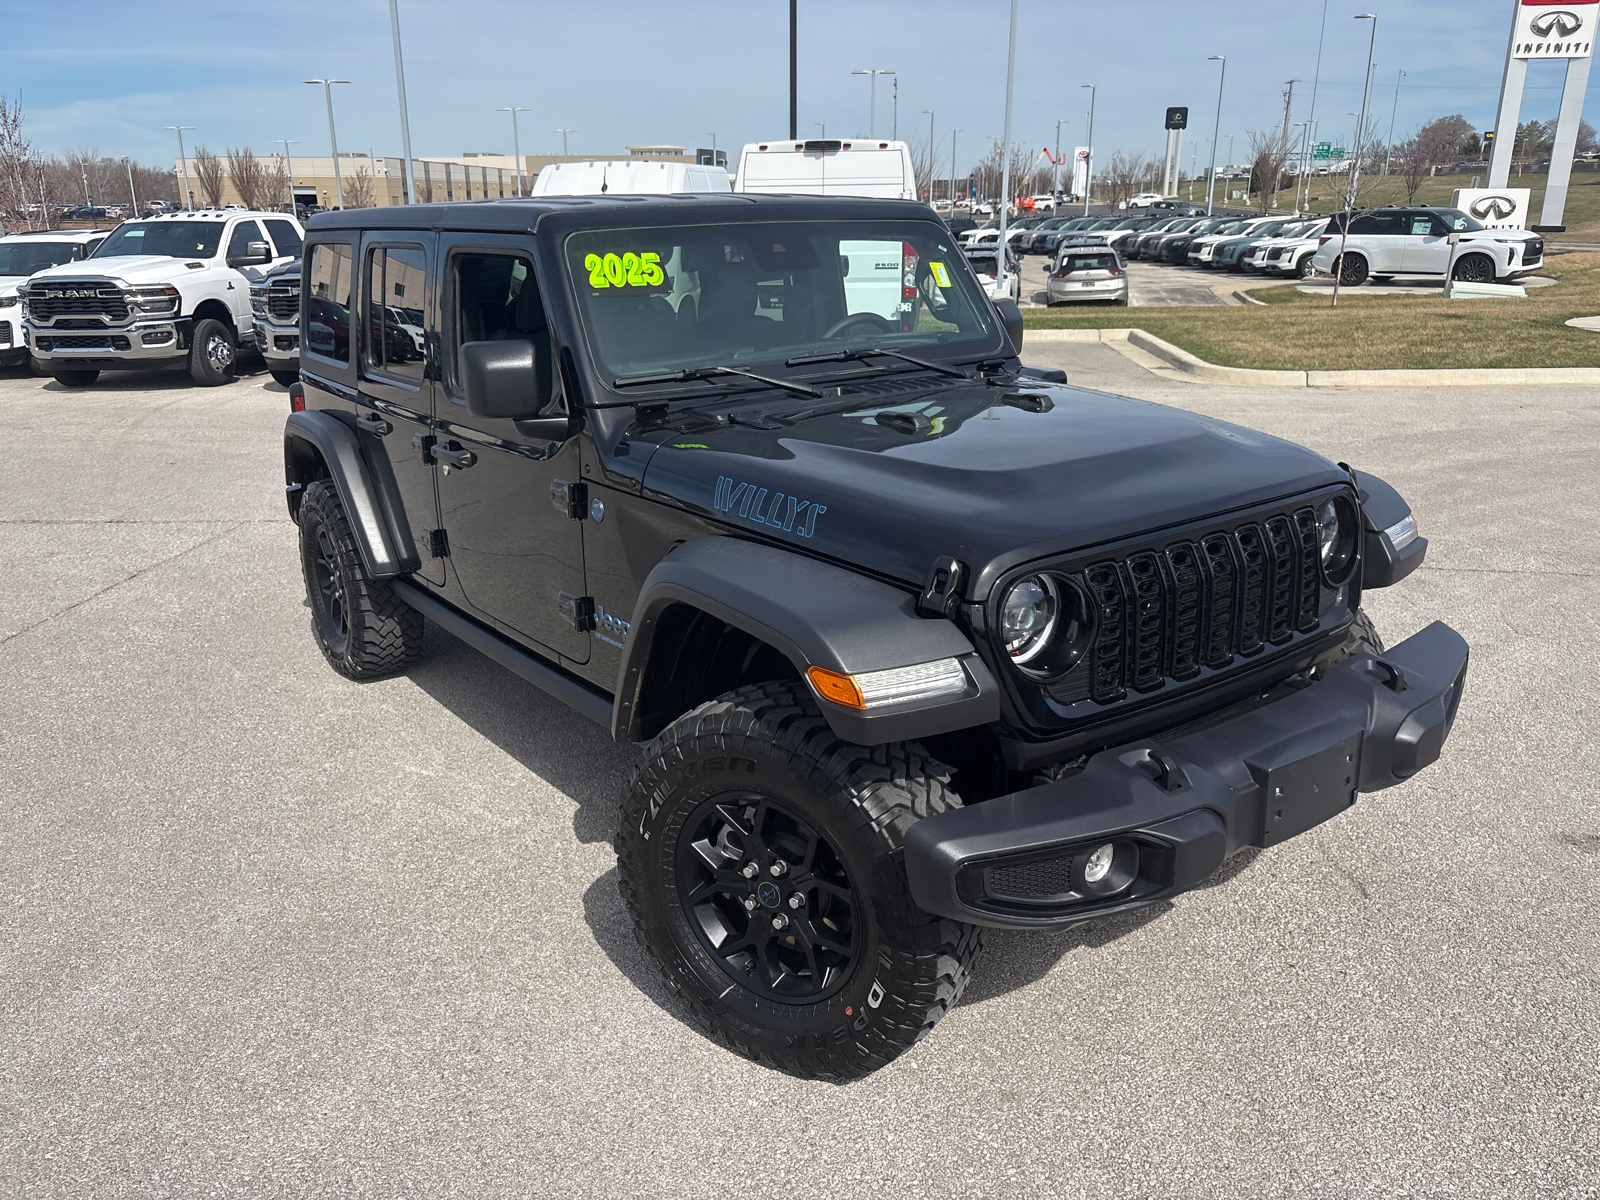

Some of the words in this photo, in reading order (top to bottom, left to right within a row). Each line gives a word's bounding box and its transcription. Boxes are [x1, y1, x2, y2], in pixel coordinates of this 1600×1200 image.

[1516, 42, 1590, 54] INFINITI
[584, 252, 664, 289] 2025
[48, 289, 96, 298] RAM
[713, 475, 828, 538] WILLYS
